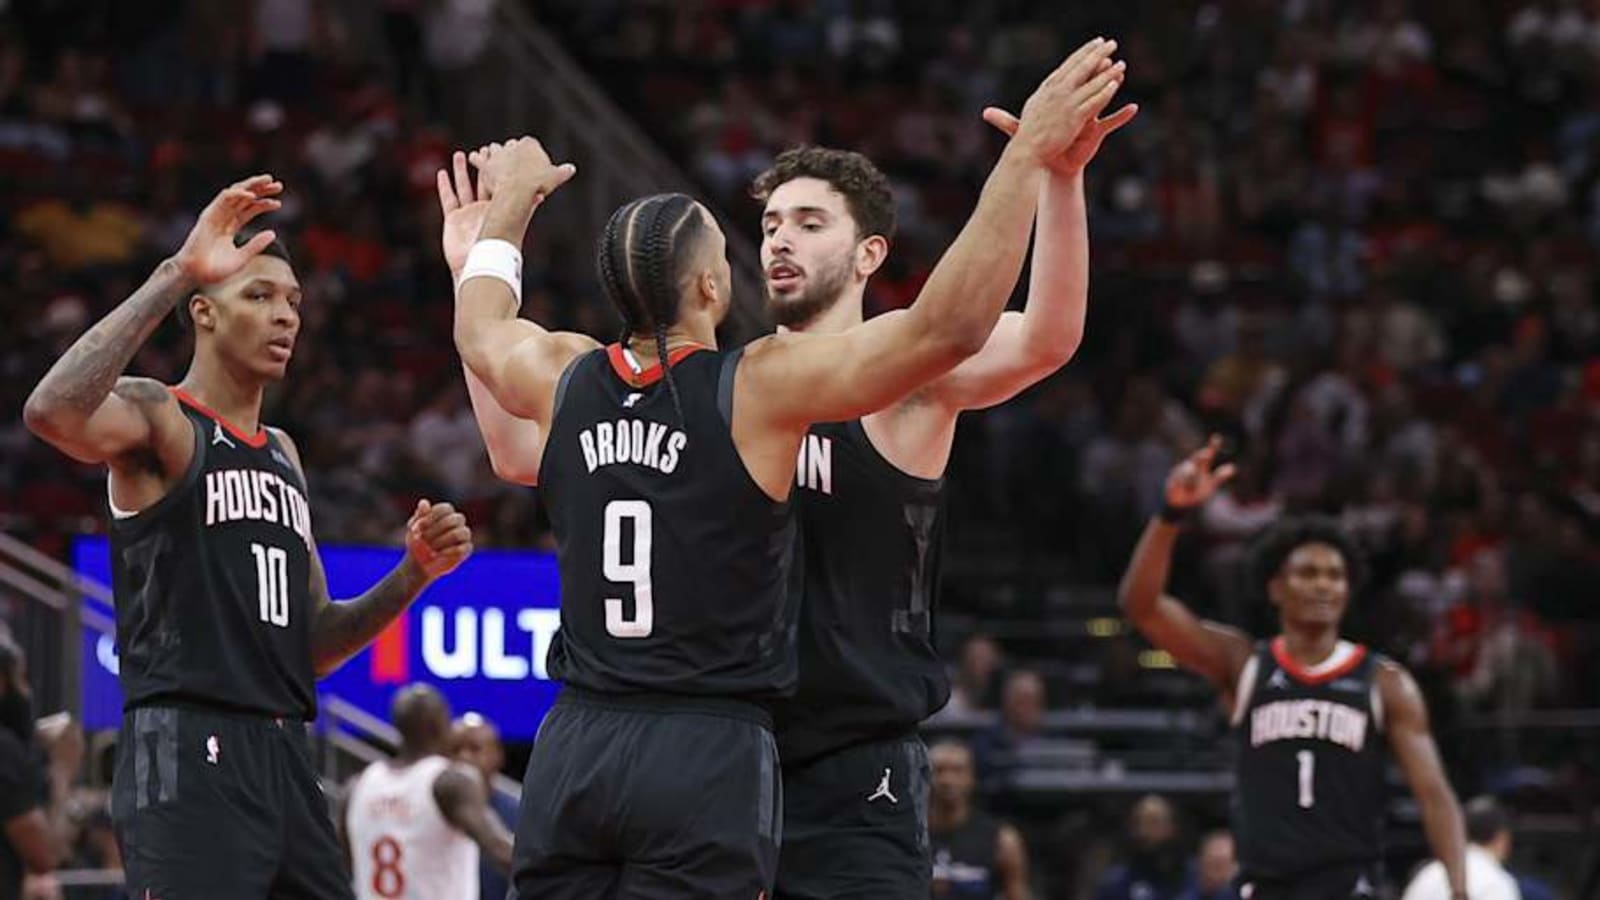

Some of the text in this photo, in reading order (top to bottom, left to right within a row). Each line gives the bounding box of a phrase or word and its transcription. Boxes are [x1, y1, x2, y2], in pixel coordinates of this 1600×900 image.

[579, 418, 687, 475] BROOKS
[251, 542, 290, 628] 10
[602, 500, 653, 638] 9
[421, 605, 562, 680] ULT
[1251, 699, 1368, 752] HOUSTON
[1296, 749, 1315, 808] 1
[371, 835, 405, 899] 8
